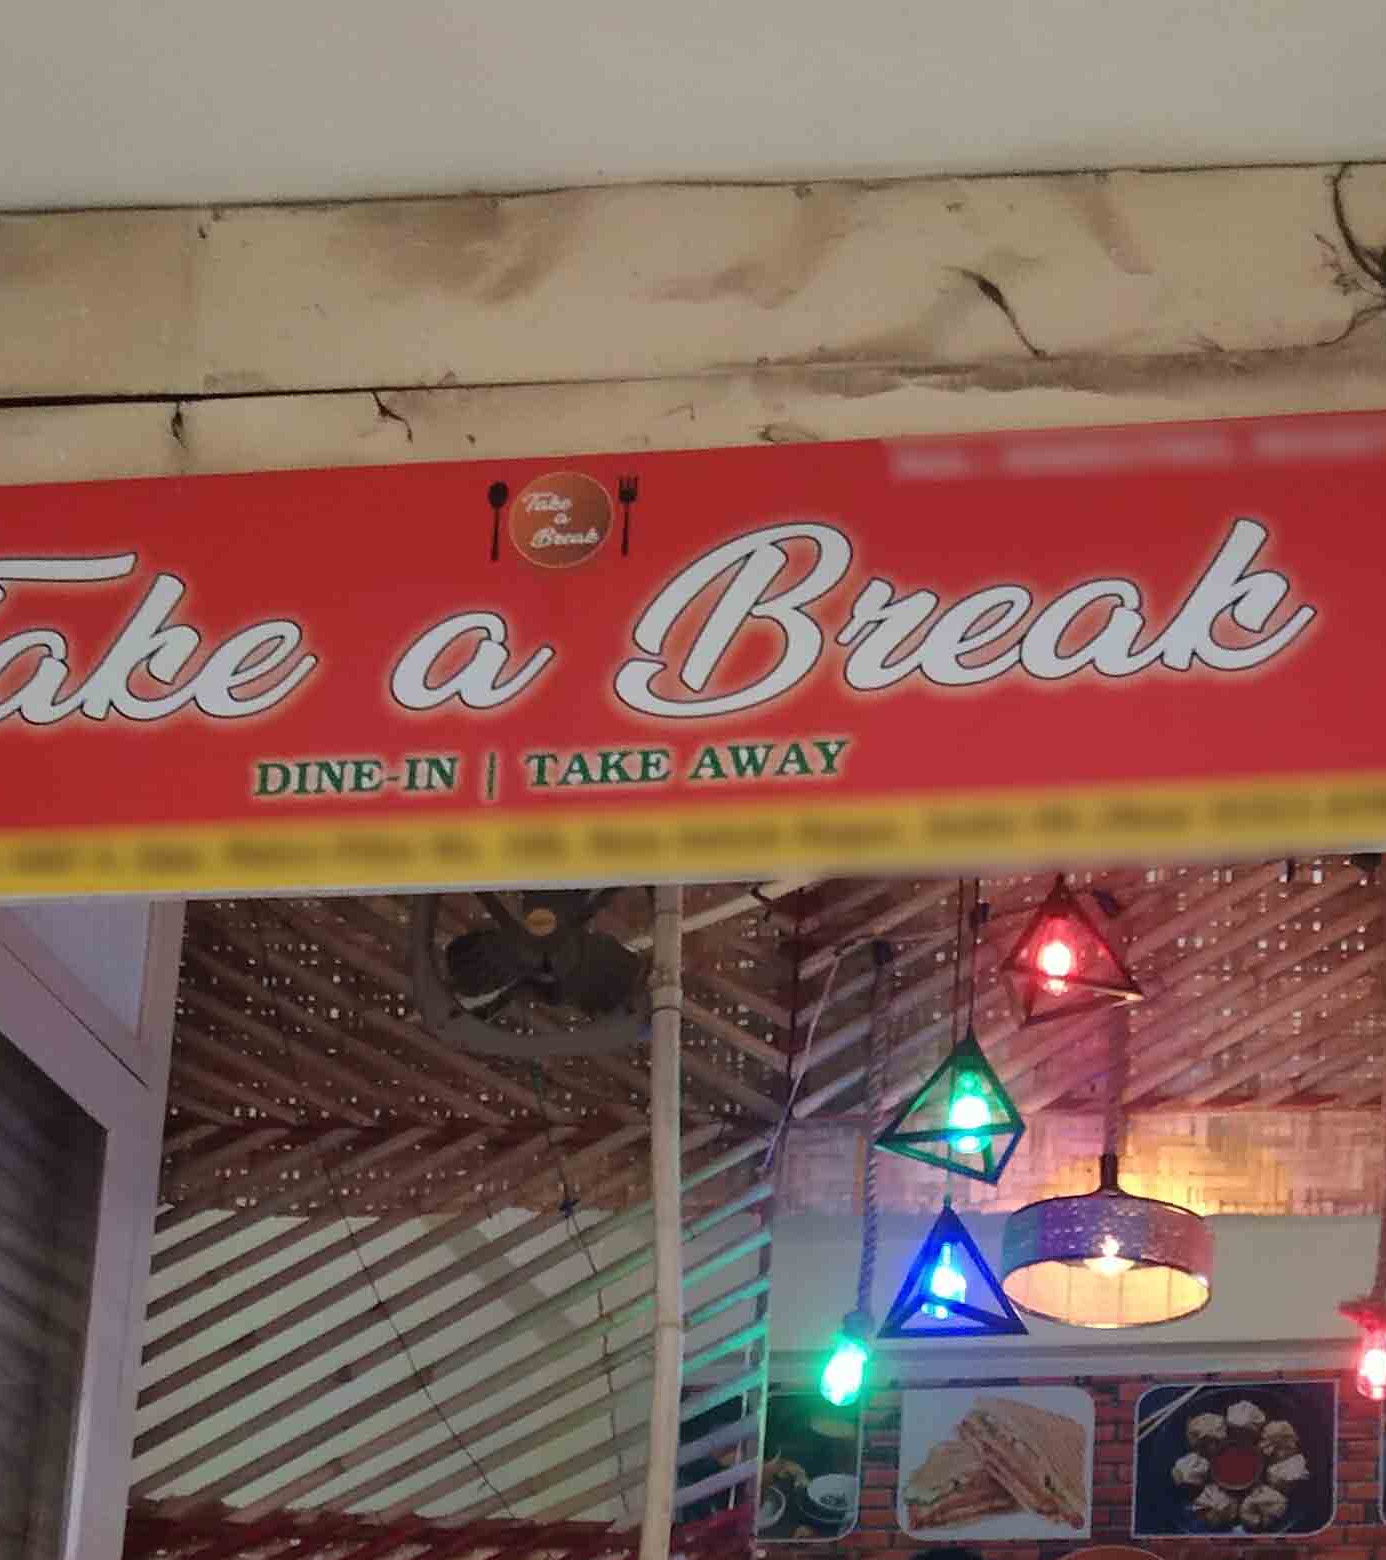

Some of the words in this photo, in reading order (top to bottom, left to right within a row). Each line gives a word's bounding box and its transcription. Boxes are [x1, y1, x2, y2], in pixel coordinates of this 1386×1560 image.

[390, 611, 556, 711] a
[613, 518, 1316, 718] Break
[253, 756, 460, 797] DINE-IN
[525, 747, 672, 788] TAKE
[688, 738, 852, 780] AWAY
